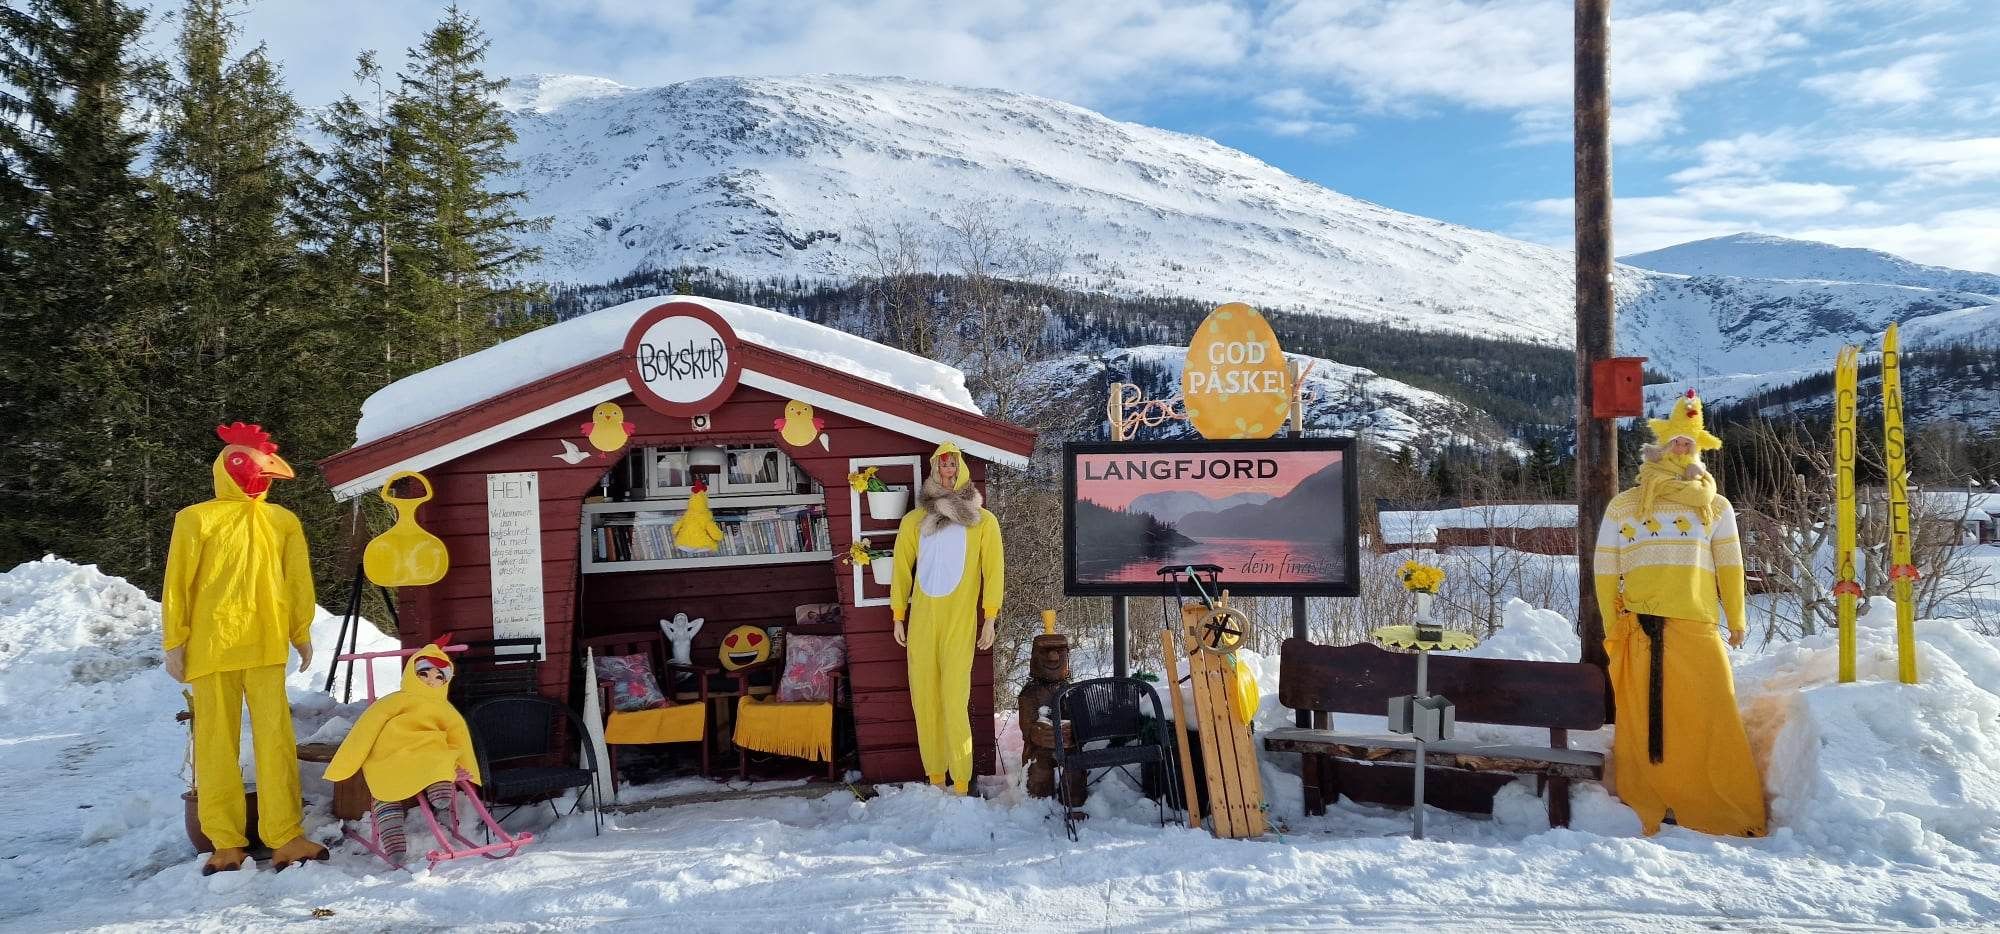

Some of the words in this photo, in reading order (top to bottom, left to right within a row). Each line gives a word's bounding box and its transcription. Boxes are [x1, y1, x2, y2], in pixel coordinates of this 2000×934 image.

[1208, 341, 1266, 365] GOD
[1188, 365, 1286, 395] PÅSKE!
[1837, 389, 1855, 500] GOD
[1085, 459, 1279, 481] LANGFJORD
[497, 537, 507, 546] Ta
[510, 537, 528, 545] med
[1241, 552, 1275, 574] dein
